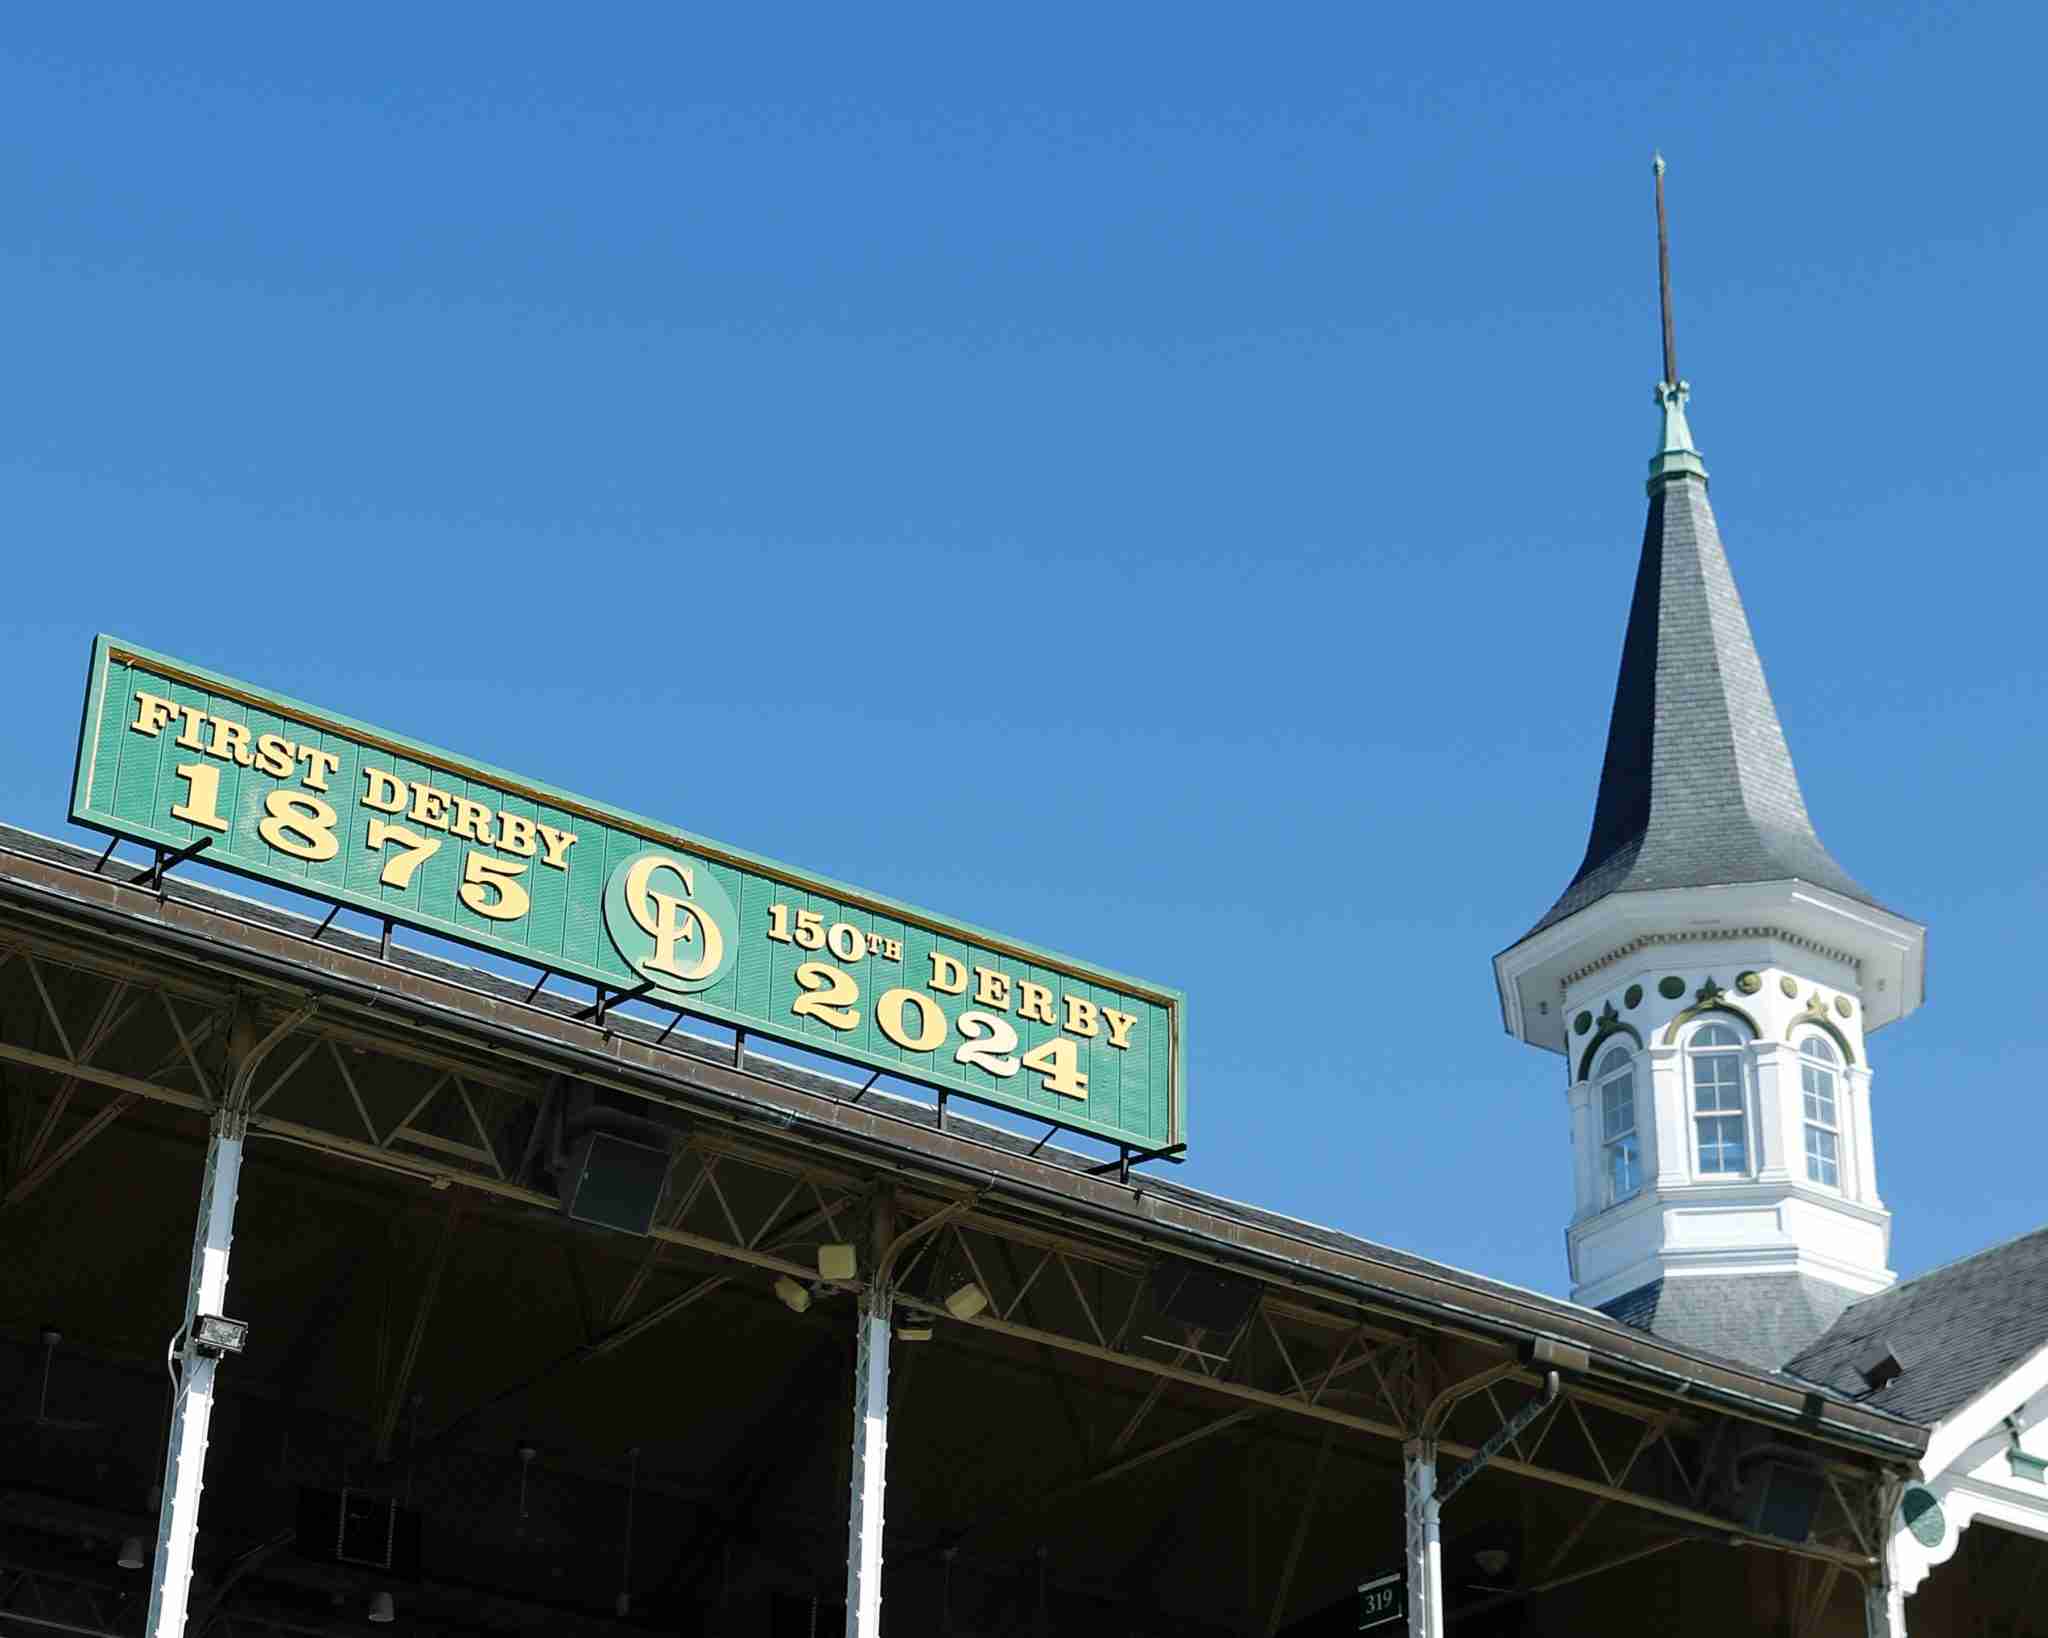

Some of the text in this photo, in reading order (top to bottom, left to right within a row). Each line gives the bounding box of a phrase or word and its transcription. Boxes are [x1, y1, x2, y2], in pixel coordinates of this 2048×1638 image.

[132, 691, 576, 869] FIRST DERBY
[172, 763, 529, 918] 1875
[793, 963, 1088, 1099] 2024
[929, 951, 1136, 1047] DERBY
[1365, 1588, 1393, 1614] 319
